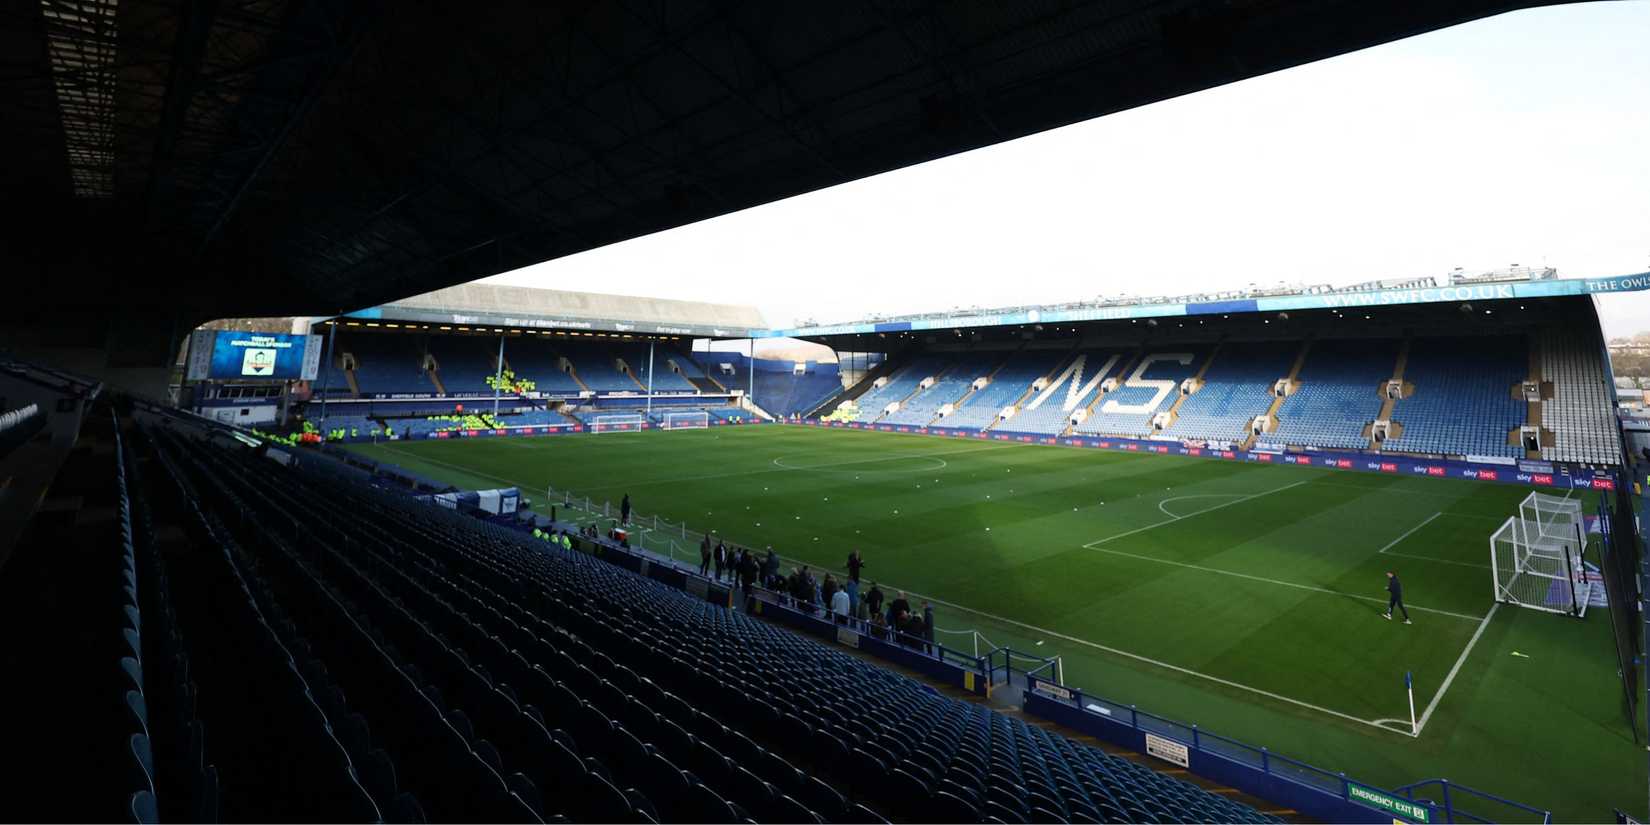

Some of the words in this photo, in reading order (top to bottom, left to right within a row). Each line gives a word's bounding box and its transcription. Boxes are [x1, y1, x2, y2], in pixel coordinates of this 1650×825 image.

[1586, 280, 1618, 291] THE
[1322, 286, 1510, 307] WWW.SWFC.CO.UK
[1285, 455, 1296, 464] sky
[1297, 456, 1310, 464] bet
[1325, 458, 1336, 467] sky
[1338, 459, 1350, 467] bet
[1368, 462, 1380, 470] sky
[1414, 466, 1426, 474] sky
[1464, 470, 1477, 478] sky
[1480, 471, 1496, 479] bet
[1517, 474, 1532, 483] sky
[1534, 475, 1551, 483] bet
[1575, 478, 1590, 487] sky
[1594, 480, 1612, 488] bet
[1352, 787, 1393, 808] EMERGENCY
[1396, 802, 1412, 814] EXIT
